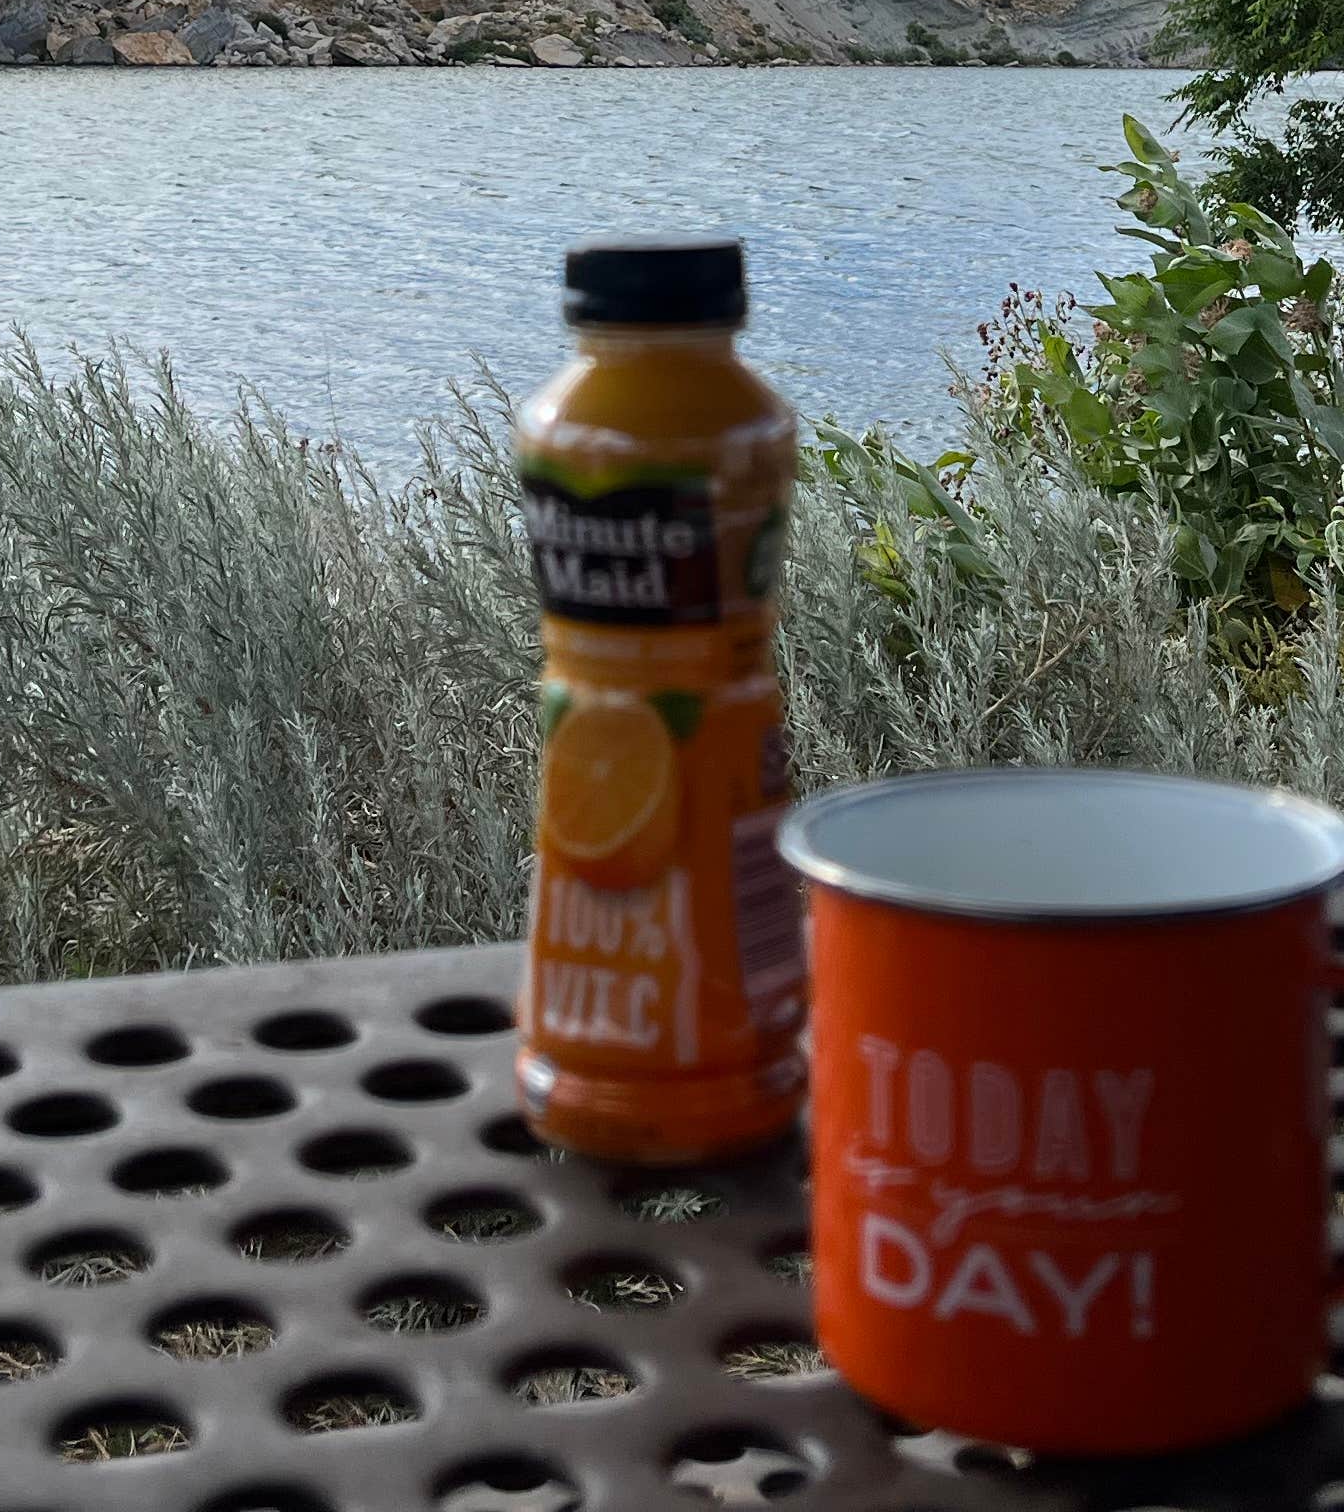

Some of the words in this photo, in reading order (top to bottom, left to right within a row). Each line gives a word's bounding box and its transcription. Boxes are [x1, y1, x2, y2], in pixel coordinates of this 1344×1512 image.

[524, 491, 696, 559] Minute
[542, 546, 668, 609] Maid
[548, 875, 668, 961] 100%
[859, 1032, 1155, 1181] TODAY
[861, 1213, 1156, 1340] DAY!
